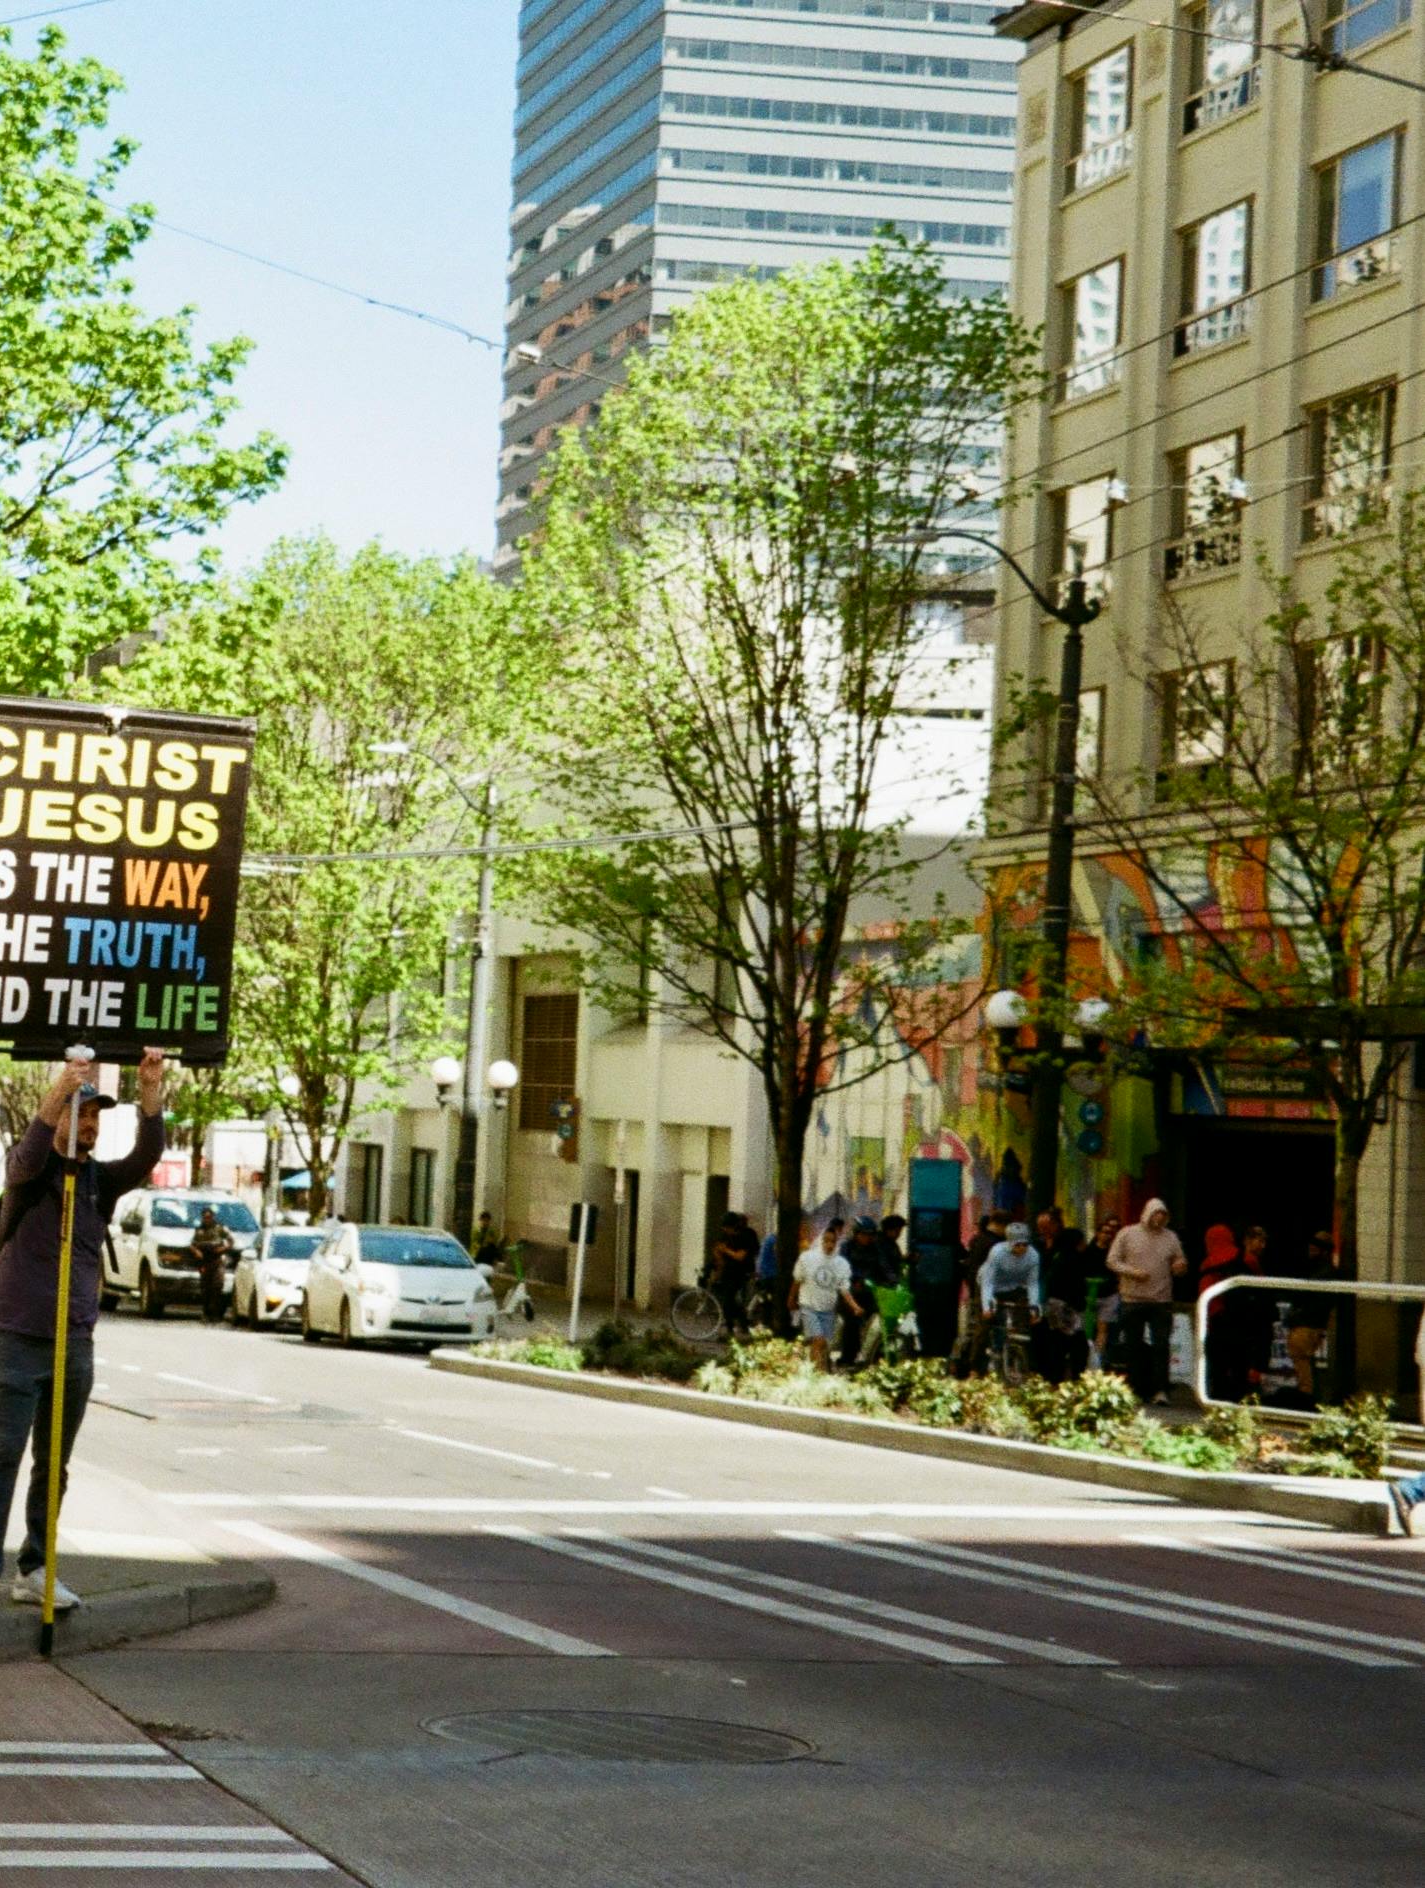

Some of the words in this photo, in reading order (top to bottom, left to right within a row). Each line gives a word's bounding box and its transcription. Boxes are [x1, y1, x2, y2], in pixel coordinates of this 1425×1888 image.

[30, 852, 114, 905] THE
[124, 858, 209, 922] WAY,
[64, 917, 206, 982] TRUTH,
[44, 978, 125, 1028] THE
[135, 983, 220, 1032] LIFE
